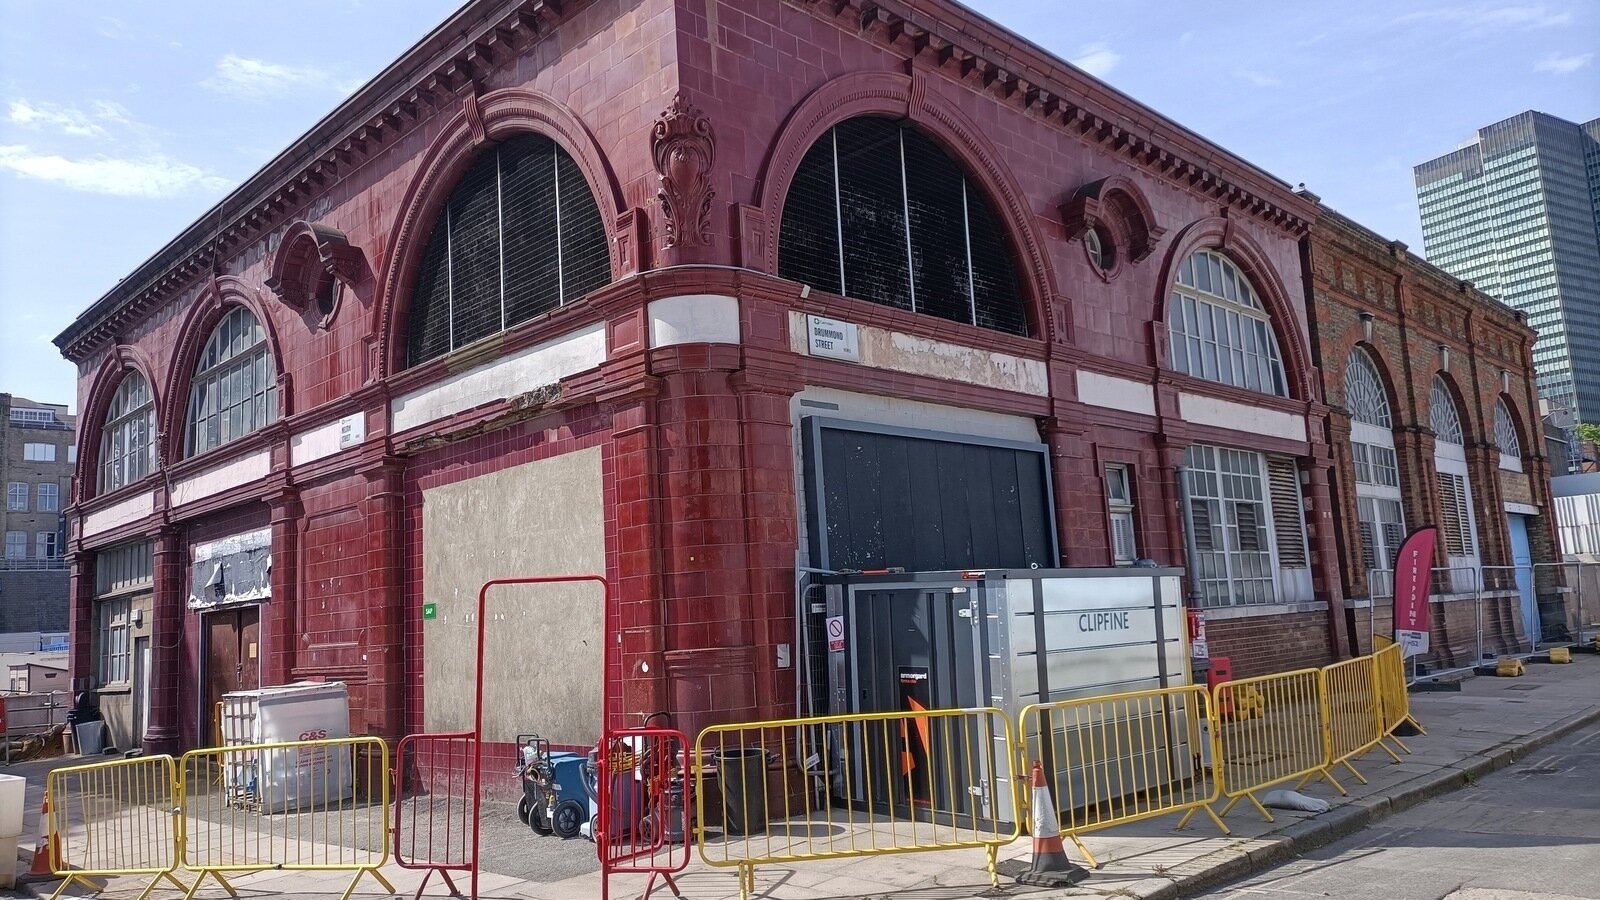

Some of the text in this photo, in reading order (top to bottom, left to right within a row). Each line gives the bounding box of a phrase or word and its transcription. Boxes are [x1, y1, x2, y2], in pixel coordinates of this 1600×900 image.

[814, 327, 843, 340] DRUMMOND
[815, 339, 833, 350] STREET
[1079, 612, 1130, 632] CLIPFINE
[299, 730, 327, 741] C&S
